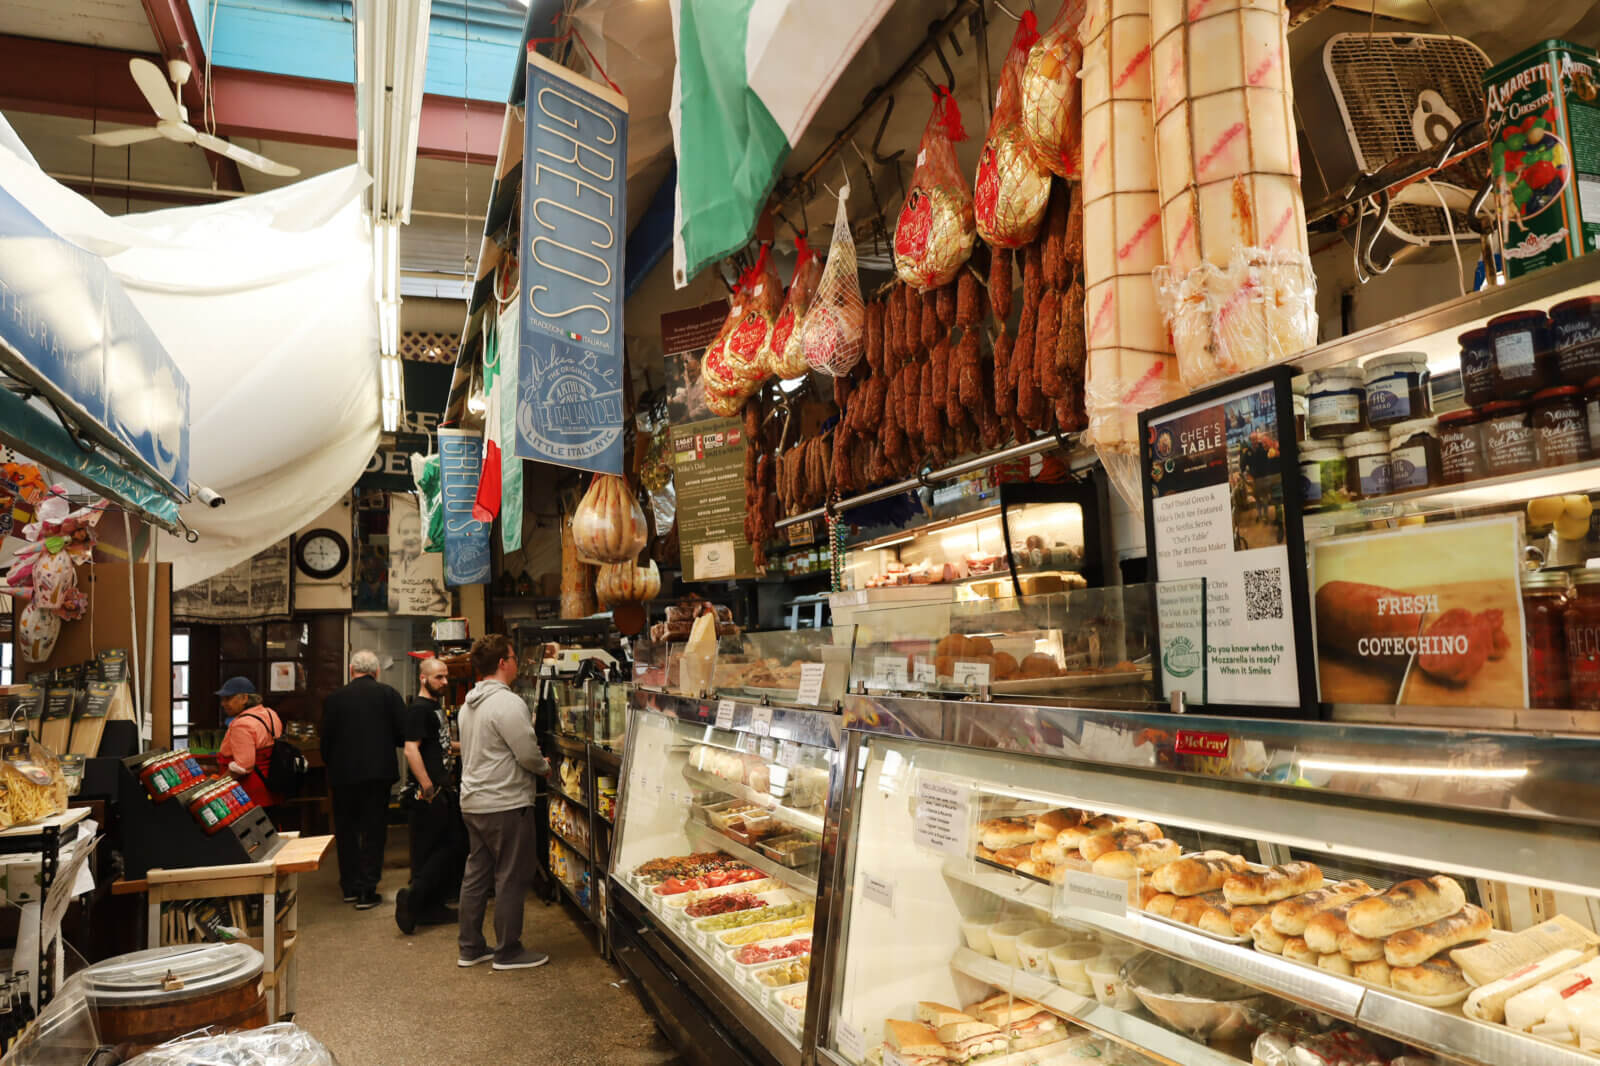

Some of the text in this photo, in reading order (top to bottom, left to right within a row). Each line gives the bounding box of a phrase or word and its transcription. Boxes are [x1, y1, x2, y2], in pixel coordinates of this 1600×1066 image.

[1487, 62, 1551, 112] AMARETTI
[530, 87, 616, 335] GRECO'S
[526, 431, 565, 456] LITTLE
[595, 431, 615, 450] NYC
[1180, 422, 1221, 444] CHEF'S
[1181, 434, 1222, 456] TABLE
[1194, 519, 1213, 529] Series
[1376, 594, 1440, 616] FRESH
[1207, 641, 1284, 655] Do you know when the
[1357, 634, 1469, 656] COTECHINO
[1211, 654, 1280, 666] Mozzarella is ready?
[1220, 666, 1240, 675] When
[1248, 665, 1272, 675] Smiles
[1180, 734, 1226, 753] McCray
